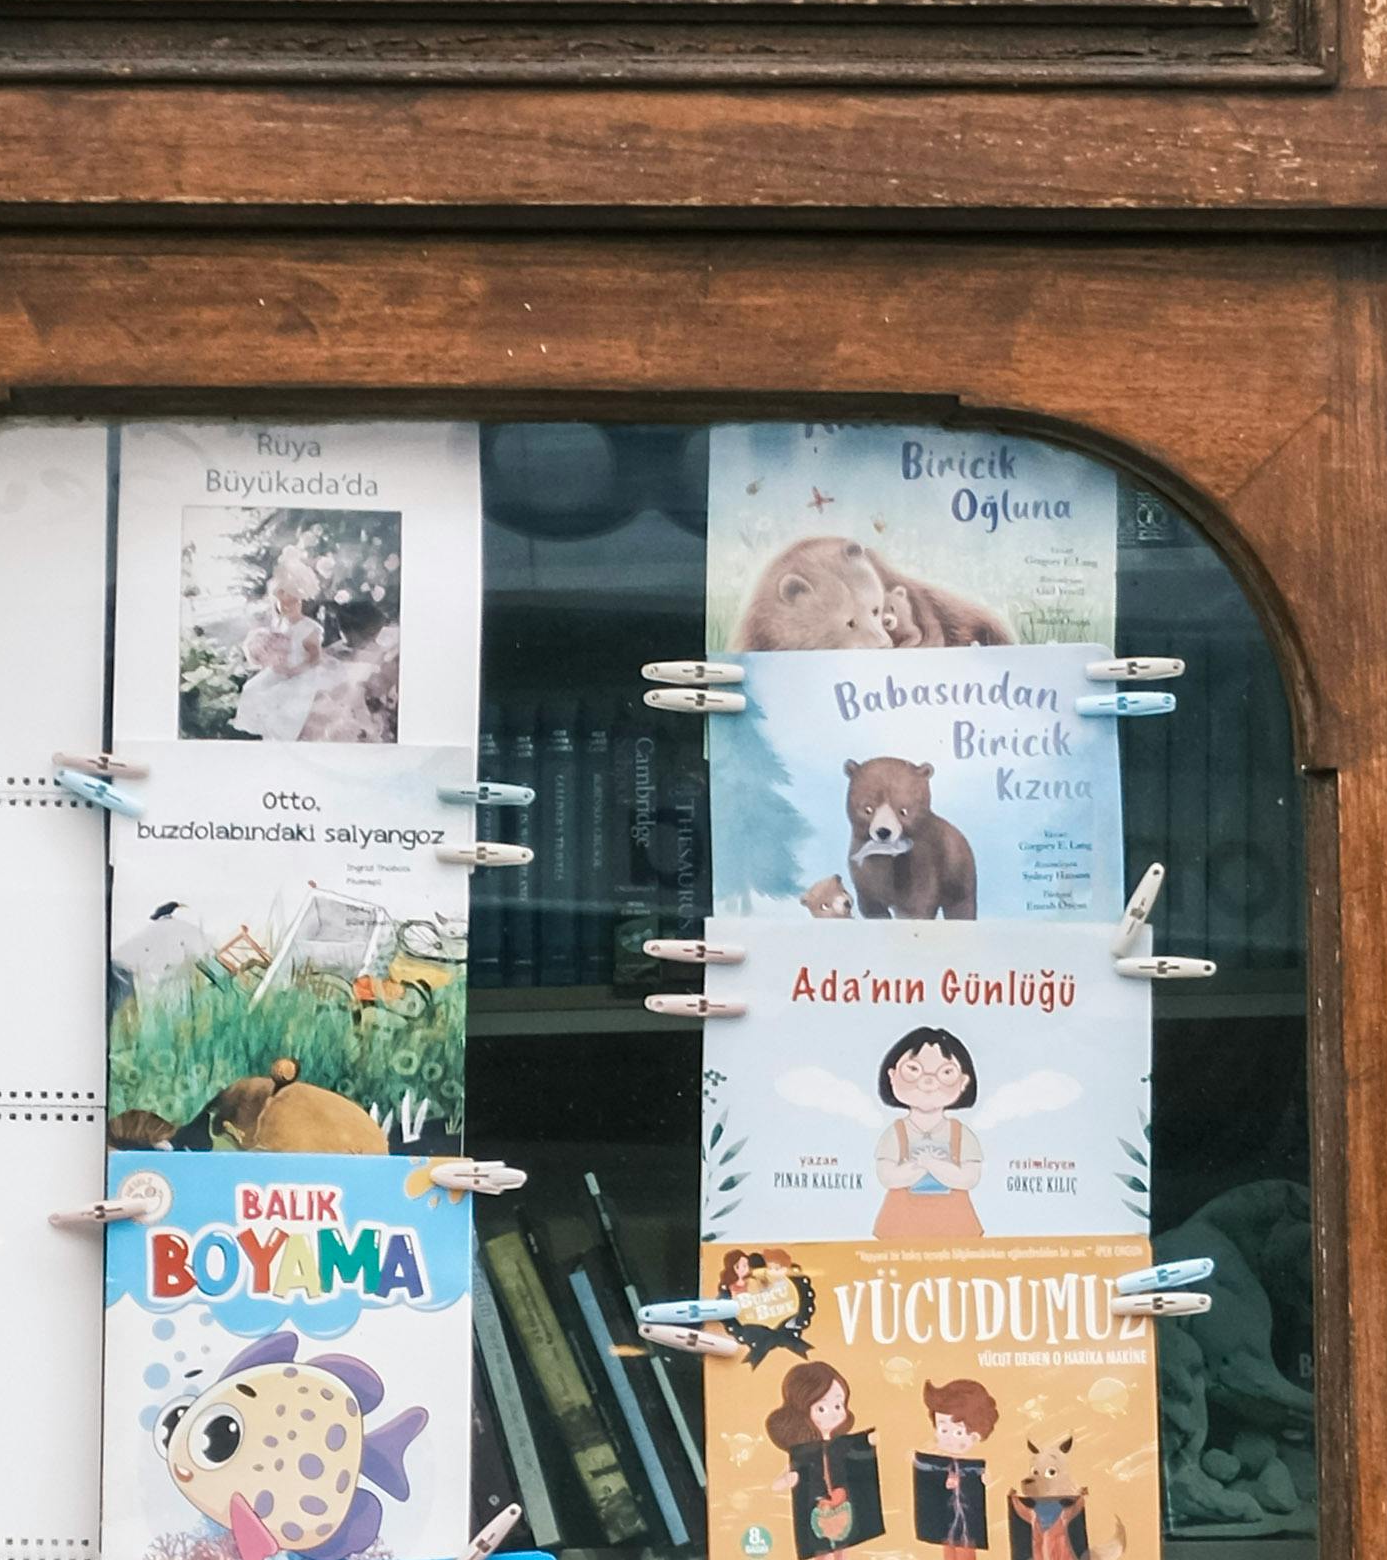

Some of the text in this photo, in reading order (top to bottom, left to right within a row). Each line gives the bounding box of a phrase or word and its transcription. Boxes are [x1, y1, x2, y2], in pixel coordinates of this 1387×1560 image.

[257, 433, 322, 459] Rüya
[901, 441, 1019, 481] Biricik
[205, 469, 379, 498] Büyükada'da
[951, 488, 1072, 533] Oğluna
[834, 671, 1059, 721] Babasından
[952, 721, 1072, 760] Biricik
[996, 767, 1094, 802] Kızına
[137, 821, 445, 850] buzdolabındaki salyangoz
[791, 966, 1076, 1014] Ada'nın Günlüğü
[241, 1189, 339, 1222] BALIK
[152, 1227, 425, 1299] BOYAMA
